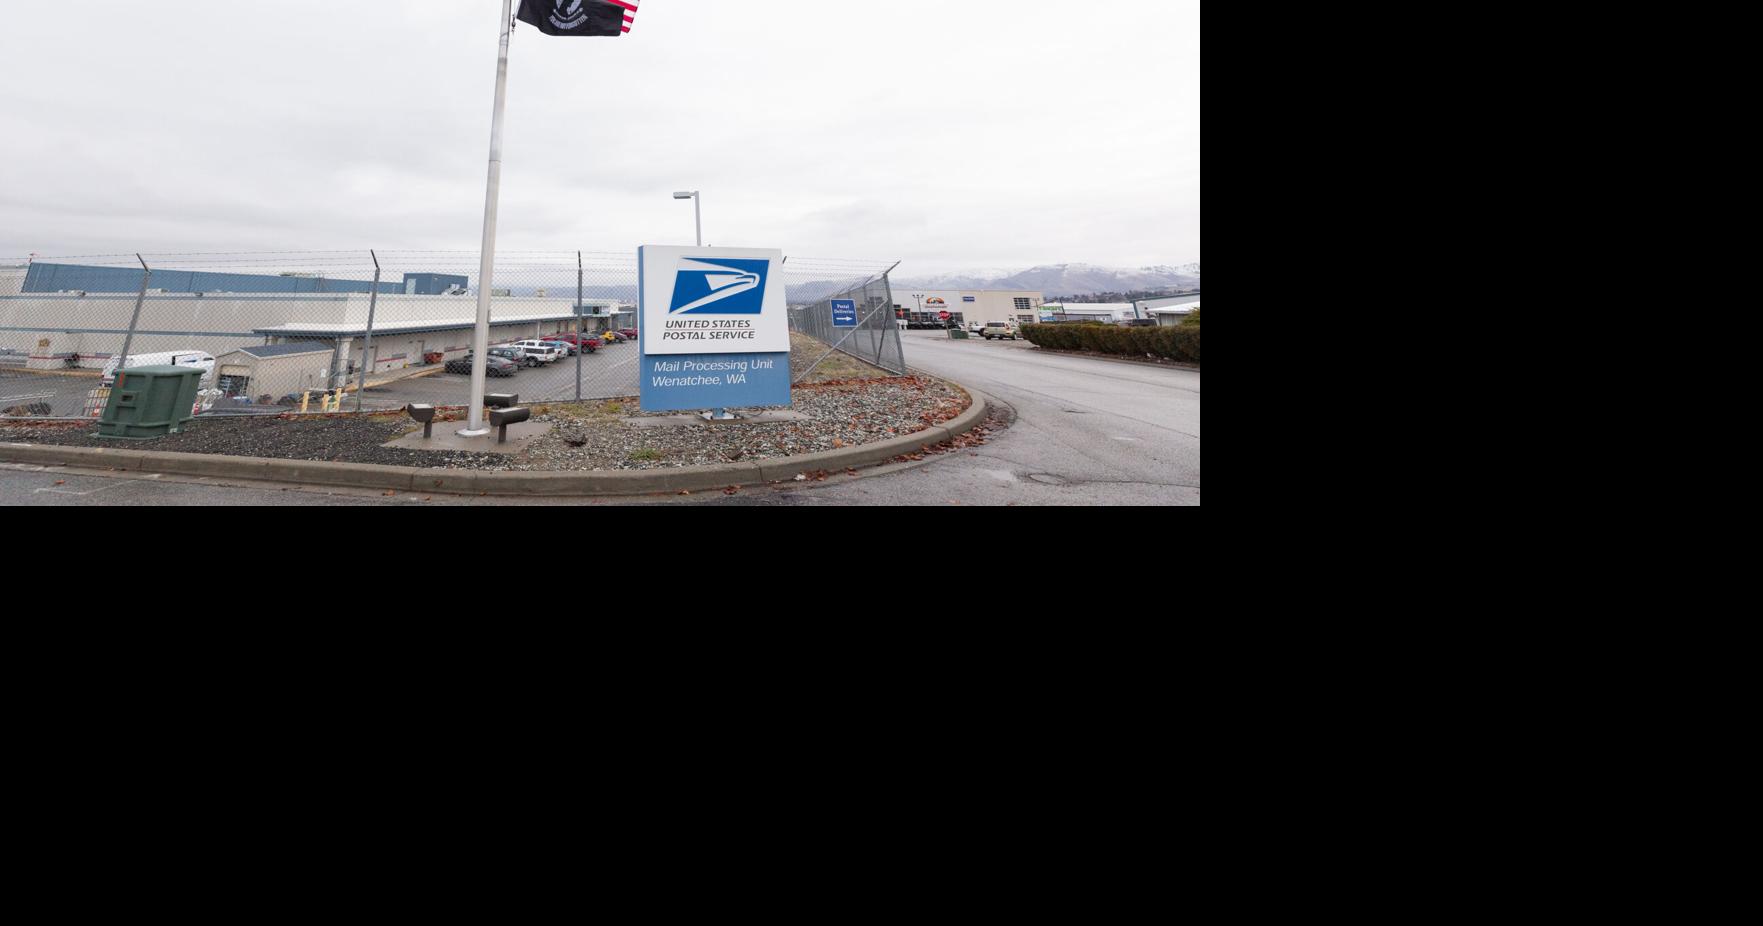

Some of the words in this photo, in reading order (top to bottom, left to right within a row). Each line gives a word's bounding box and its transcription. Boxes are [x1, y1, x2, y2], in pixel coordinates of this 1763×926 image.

[665, 320, 710, 329] UNITED
[711, 319, 751, 328] STATES
[663, 332, 706, 340] POSTAL
[709, 331, 755, 339] SERVICE
[654, 361, 680, 372] Mail
[683, 360, 748, 373] Processing
[751, 359, 773, 370] Unit
[652, 376, 722, 387] Wenatchee,
[726, 374, 746, 385] WA
